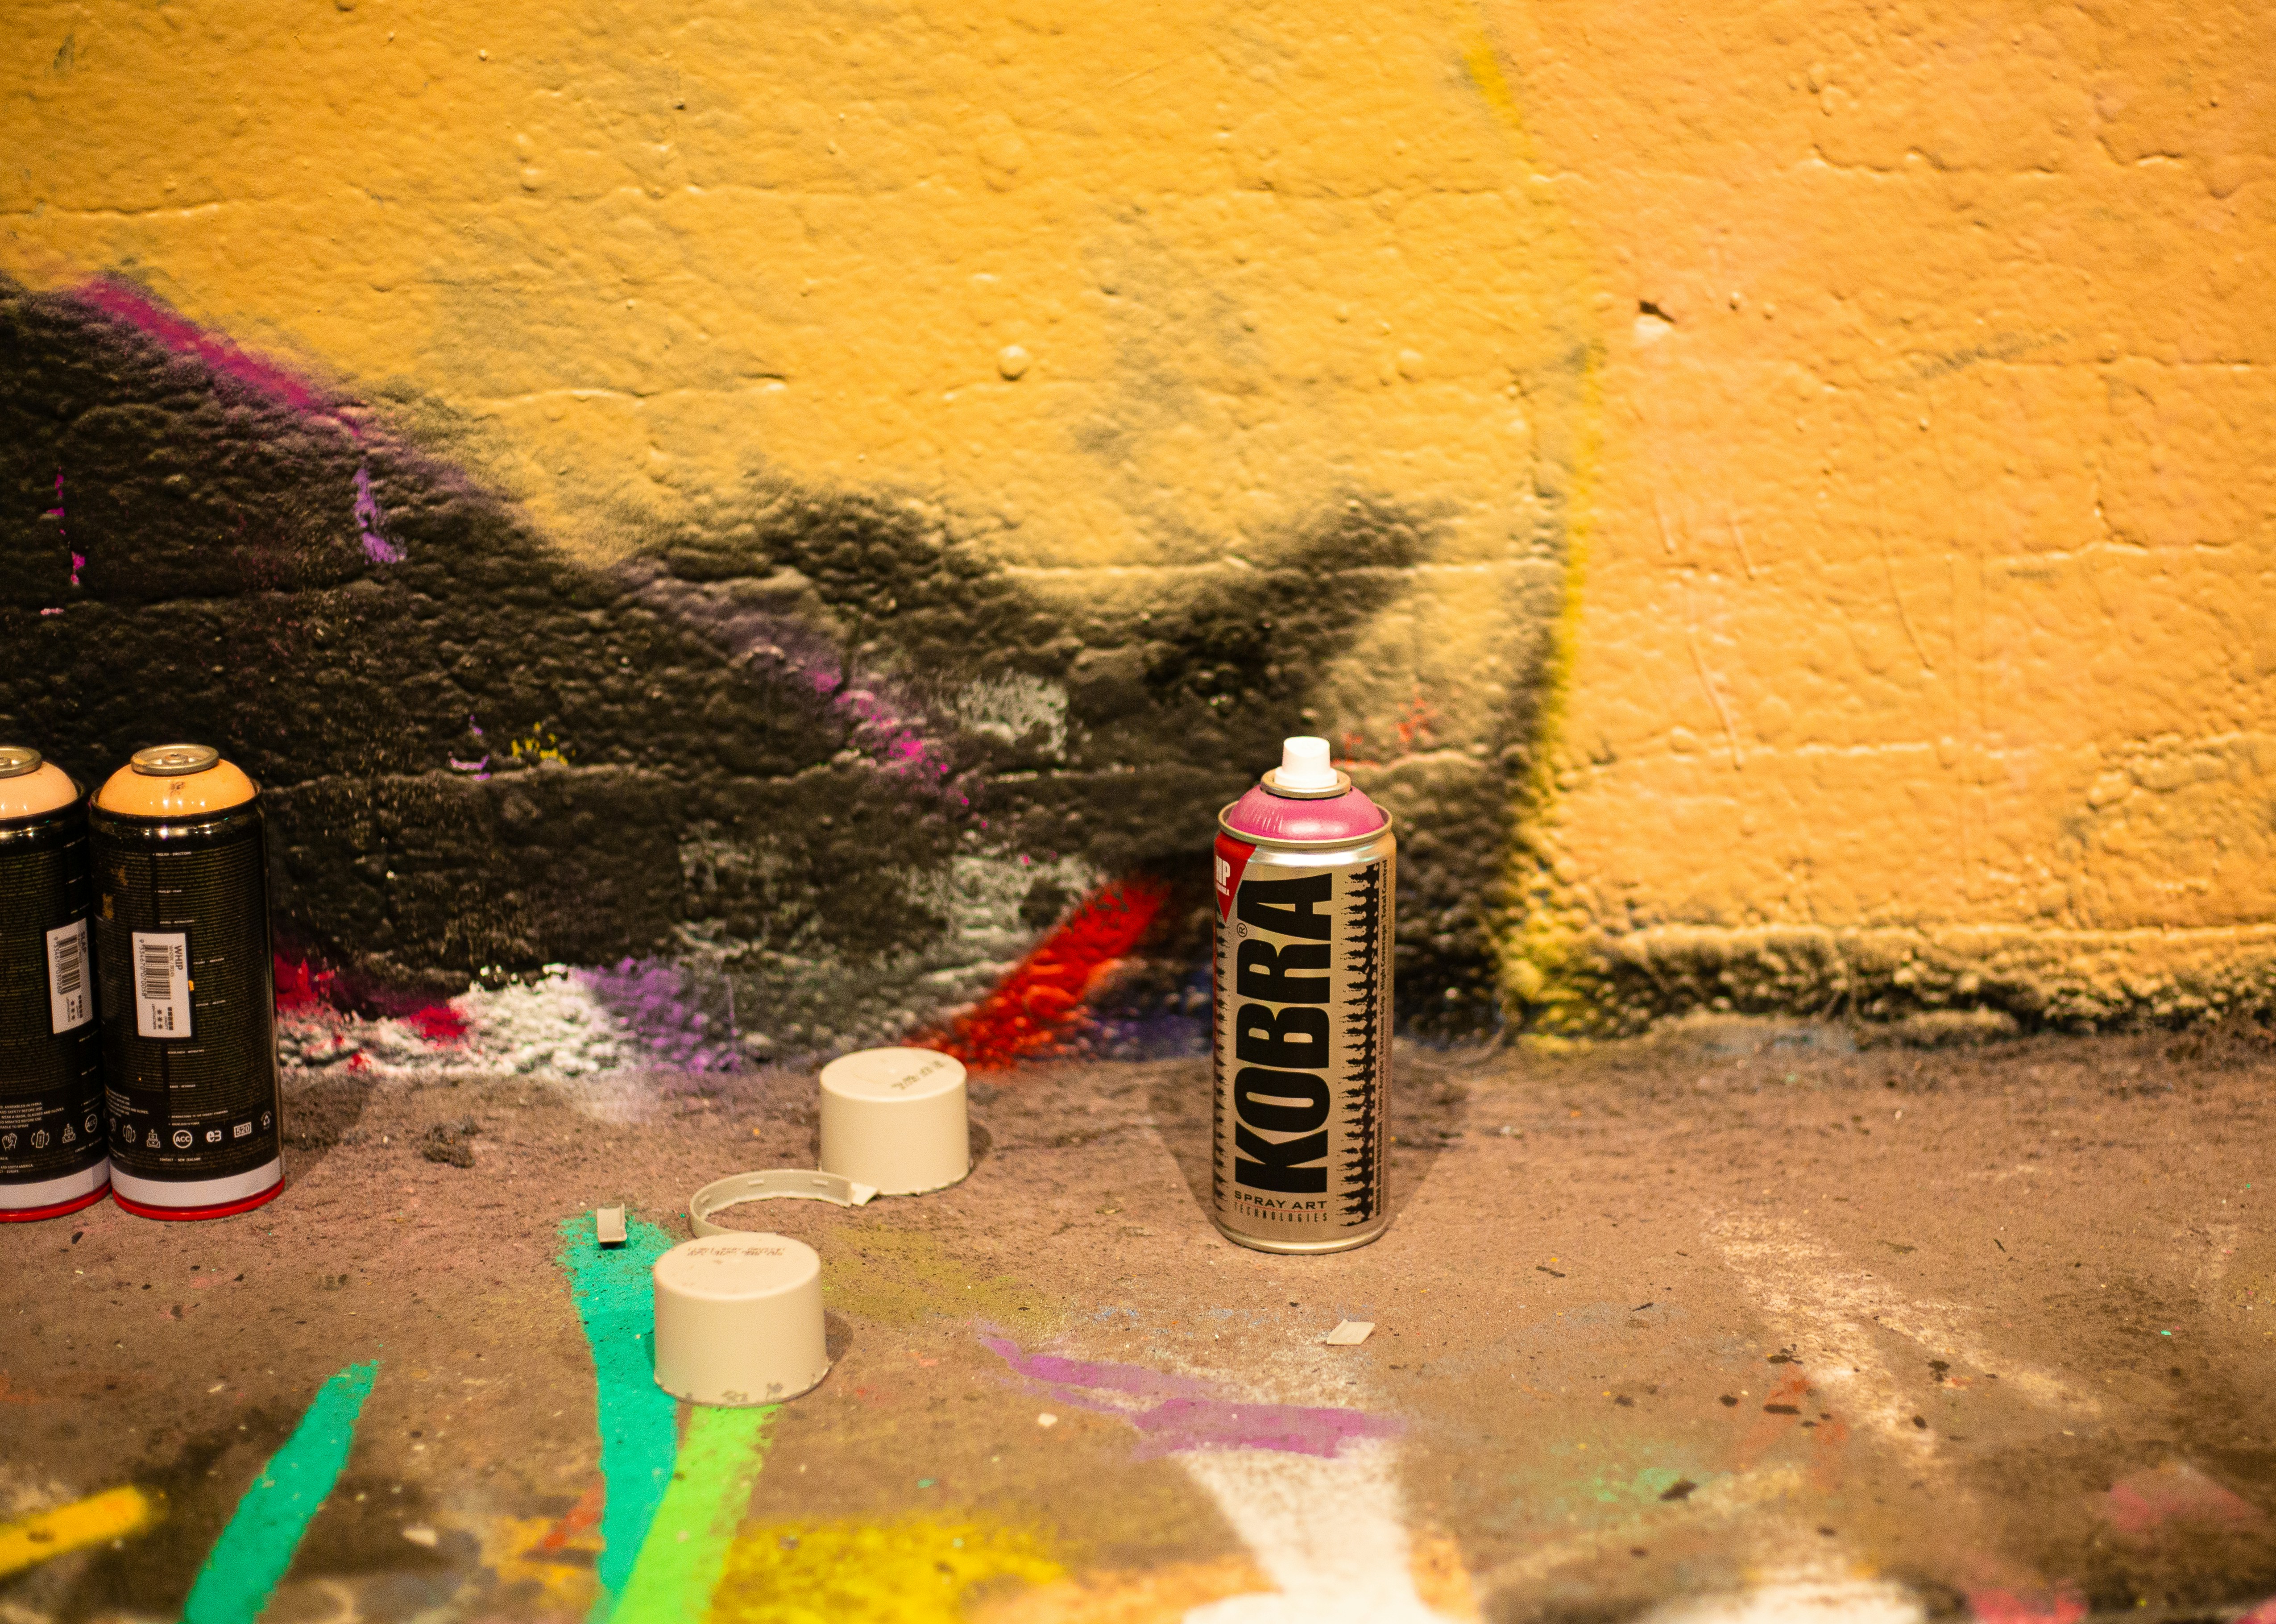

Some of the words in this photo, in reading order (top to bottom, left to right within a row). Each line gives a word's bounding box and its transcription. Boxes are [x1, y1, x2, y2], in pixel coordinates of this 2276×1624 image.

[174, 945, 183, 970] WHIP
[1234, 872, 1332, 1193] KOBRA
[236, 1125, 250, 1135] 520
[1234, 1190, 1285, 1208] SPRAY
[1292, 1201, 1327, 1209] ART
[1234, 1201, 1327, 1222] TECHNOLOGIES
